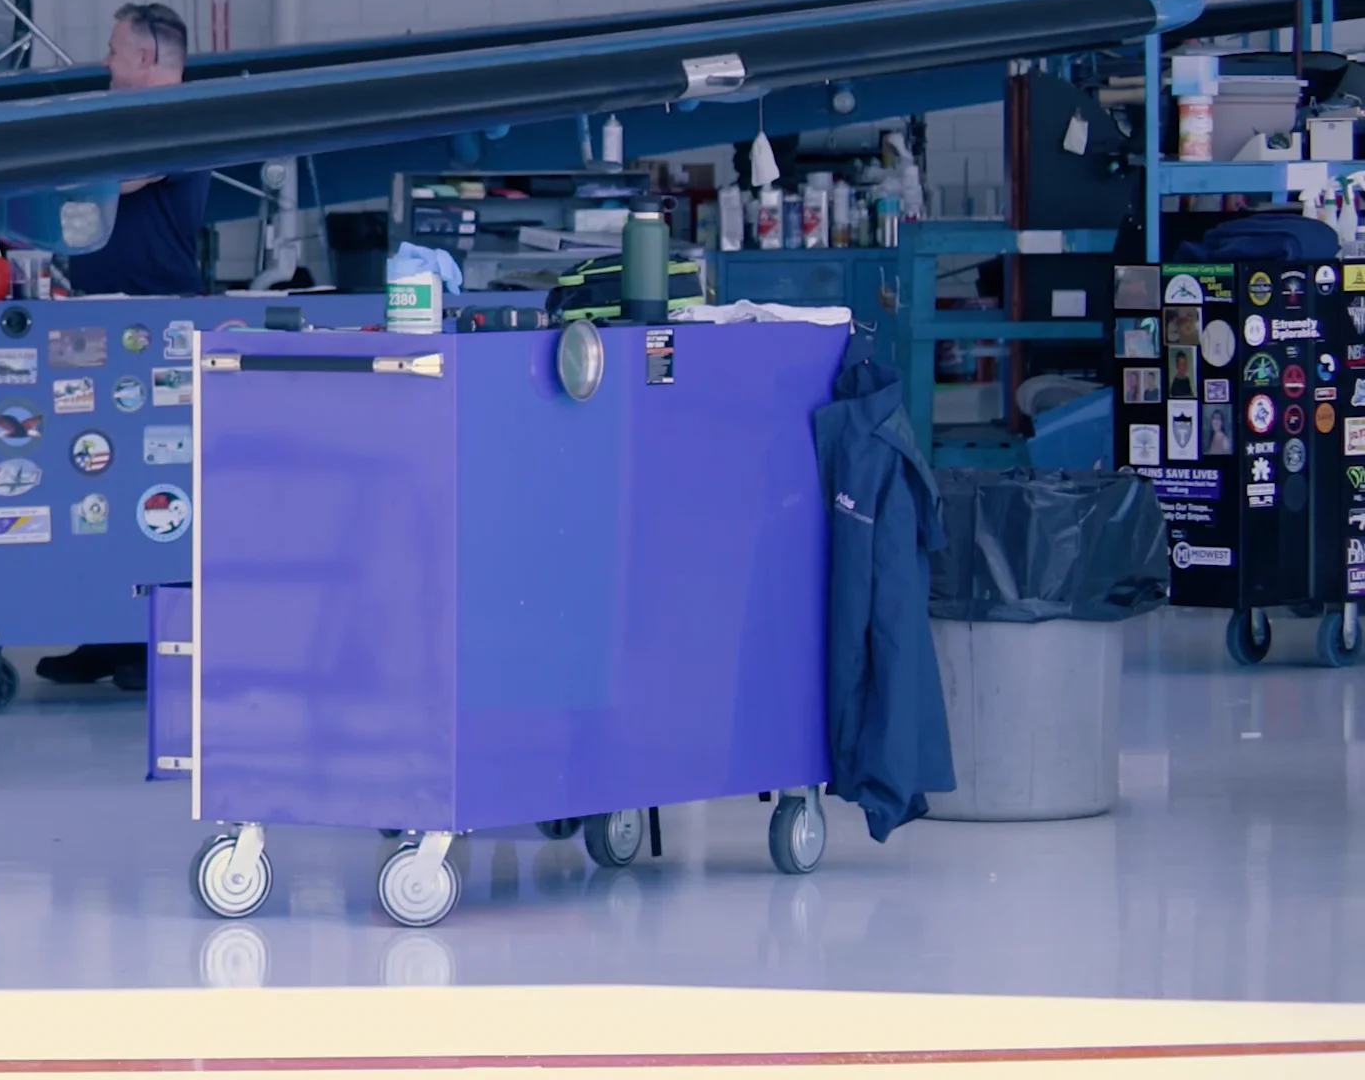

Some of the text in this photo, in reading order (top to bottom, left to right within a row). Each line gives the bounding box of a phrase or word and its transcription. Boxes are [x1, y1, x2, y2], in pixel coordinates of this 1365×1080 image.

[389, 293, 417, 306] 2380
[1137, 468, 1219, 480] GUNS SAVE LIVES
[1191, 550, 1229, 559] MIDWEST
